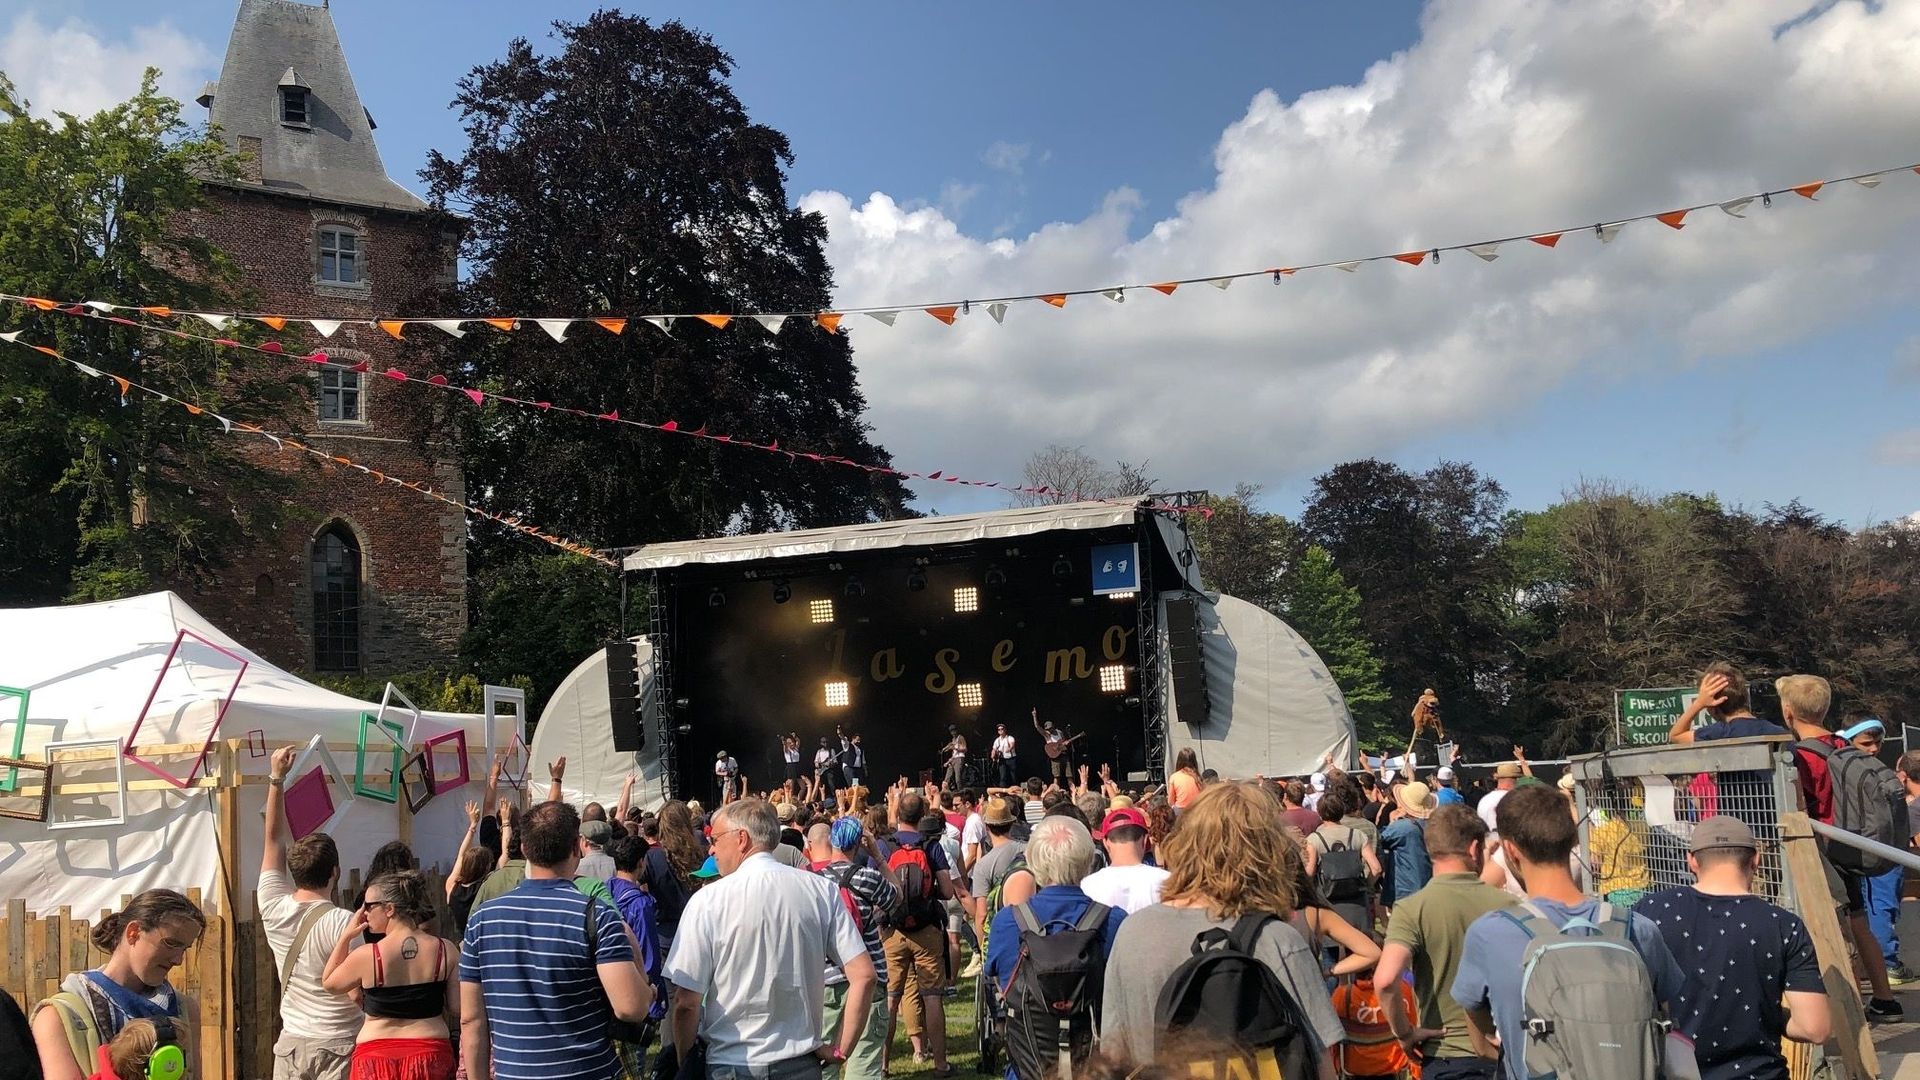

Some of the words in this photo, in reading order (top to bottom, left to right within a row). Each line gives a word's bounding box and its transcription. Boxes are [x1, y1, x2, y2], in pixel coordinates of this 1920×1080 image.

[1629, 698, 1655, 710] FIRE
[1626, 714, 1668, 727] SORTIE
[1632, 732, 1669, 745] SECOU
